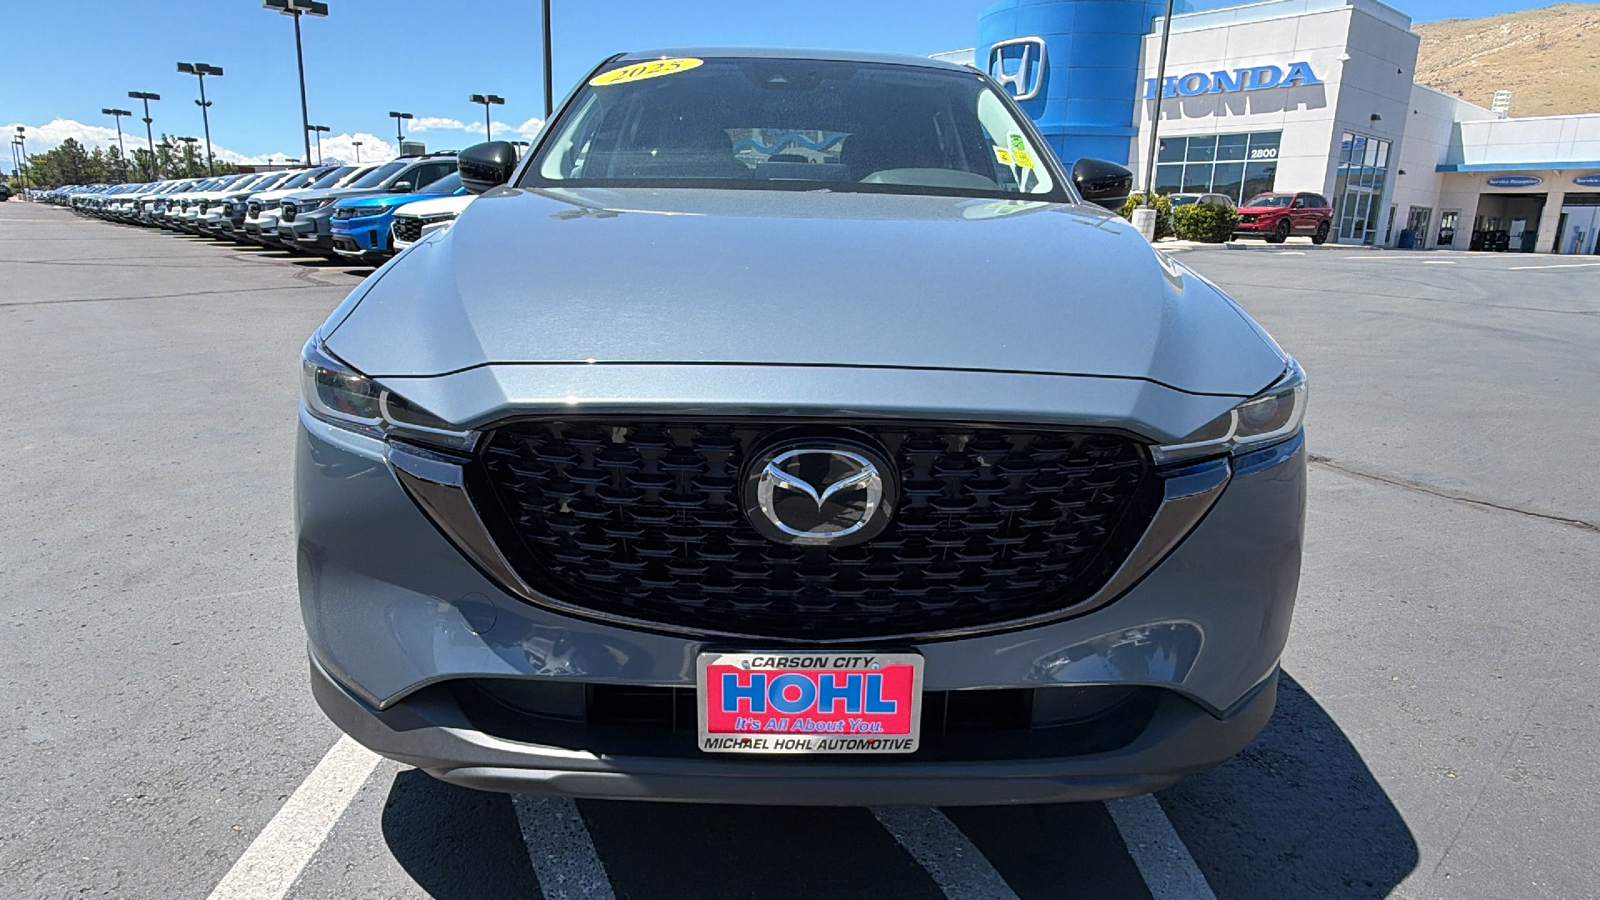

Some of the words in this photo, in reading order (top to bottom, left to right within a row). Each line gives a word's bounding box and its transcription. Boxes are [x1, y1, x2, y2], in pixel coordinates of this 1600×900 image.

[609, 60, 684, 82] 2025
[1143, 61, 1324, 99] HONDA
[1251, 148, 1277, 158] 2800
[751, 656, 828, 668] CARSON
[833, 656, 875, 668] CITY
[722, 673, 897, 713] HOHL
[735, 717, 762, 731] It's
[765, 718, 789, 731] All
[792, 718, 844, 732] About
[848, 719, 884, 733] You.
[704, 737, 769, 750] MICHAEL
[773, 738, 813, 750] HOHL
[816, 738, 914, 750] AUTOMOTIVE
